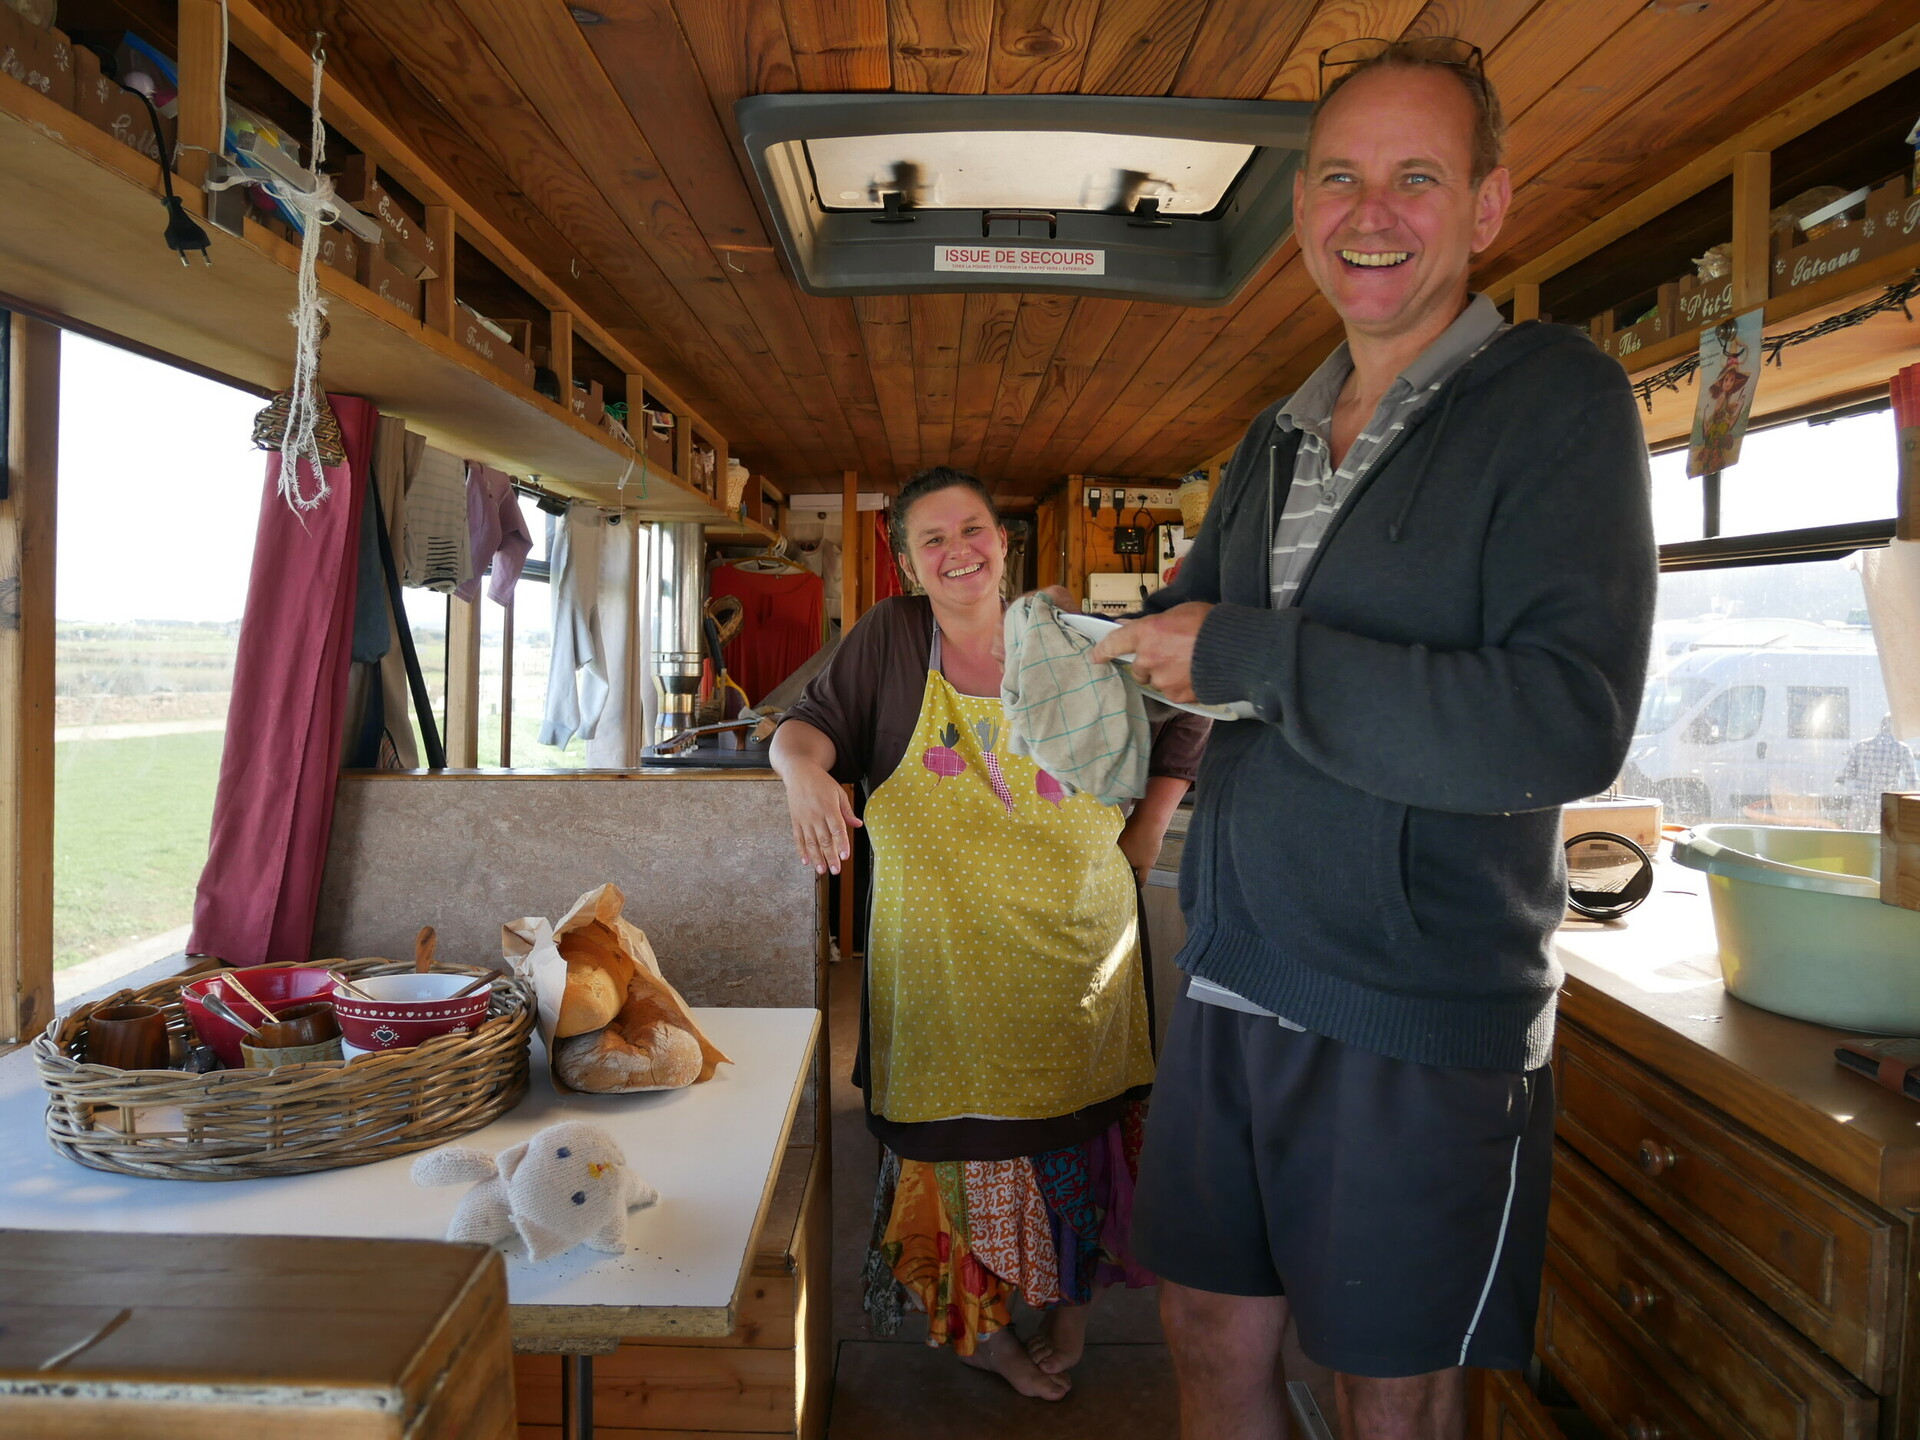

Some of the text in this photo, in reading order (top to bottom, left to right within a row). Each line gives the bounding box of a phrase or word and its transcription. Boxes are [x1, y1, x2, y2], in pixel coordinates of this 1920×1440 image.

[945, 249, 1095, 266] ISSUE DE SECOURS
[1791, 248, 1860, 287] Gâteaux
